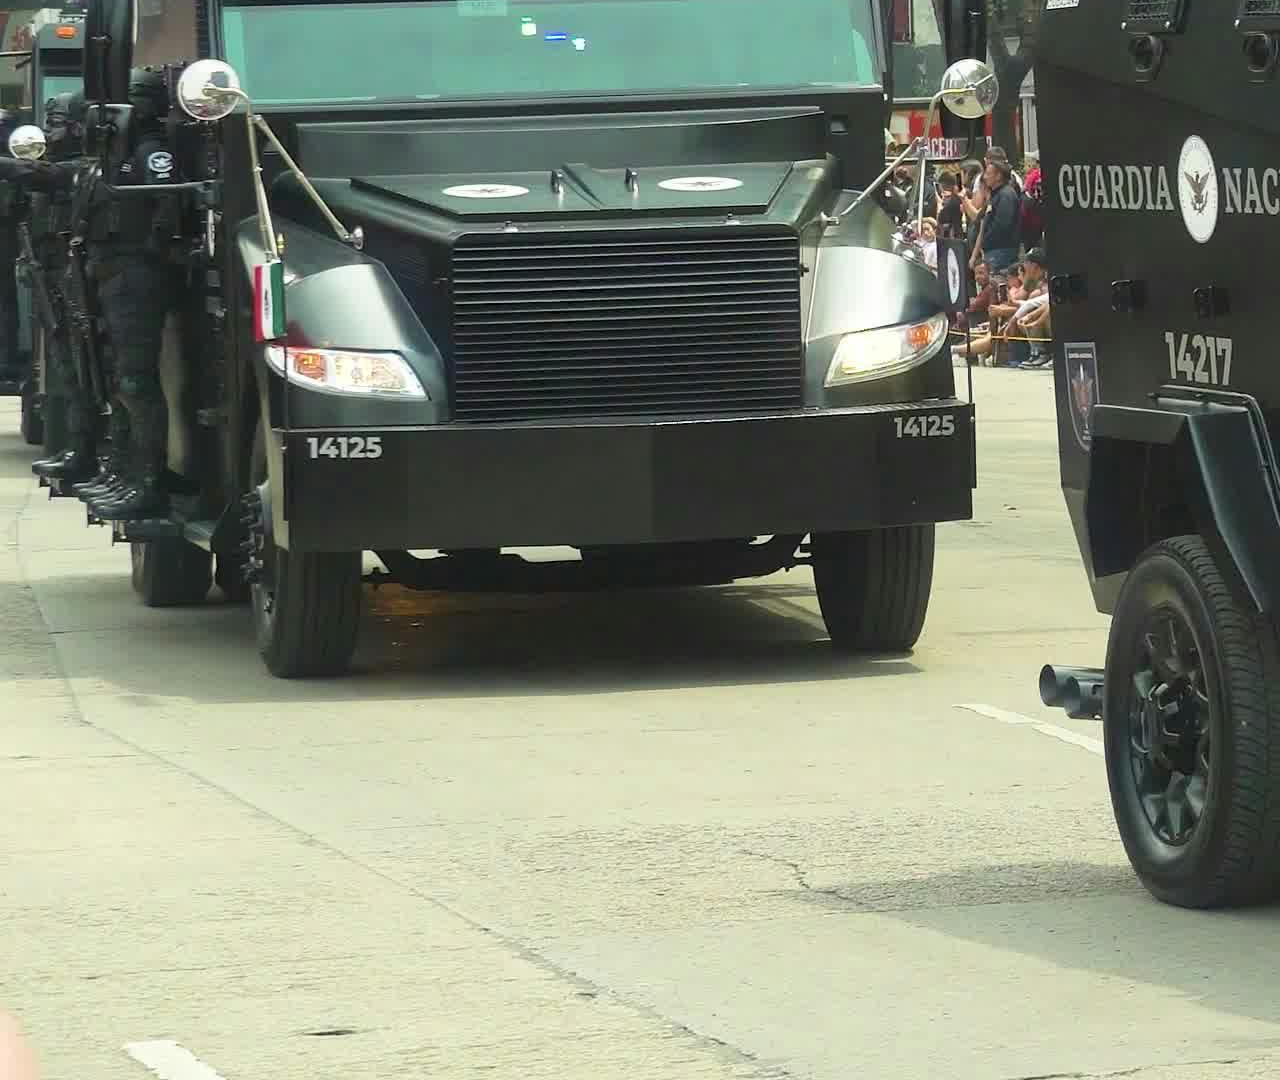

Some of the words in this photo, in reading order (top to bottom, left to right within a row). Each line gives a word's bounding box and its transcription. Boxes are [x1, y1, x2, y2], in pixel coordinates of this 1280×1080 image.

[1058, 164, 1175, 211] GUARDIA
[1165, 331, 1232, 385] 14217
[894, 414, 955, 438] 14125
[306, 436, 383, 459] 14125
